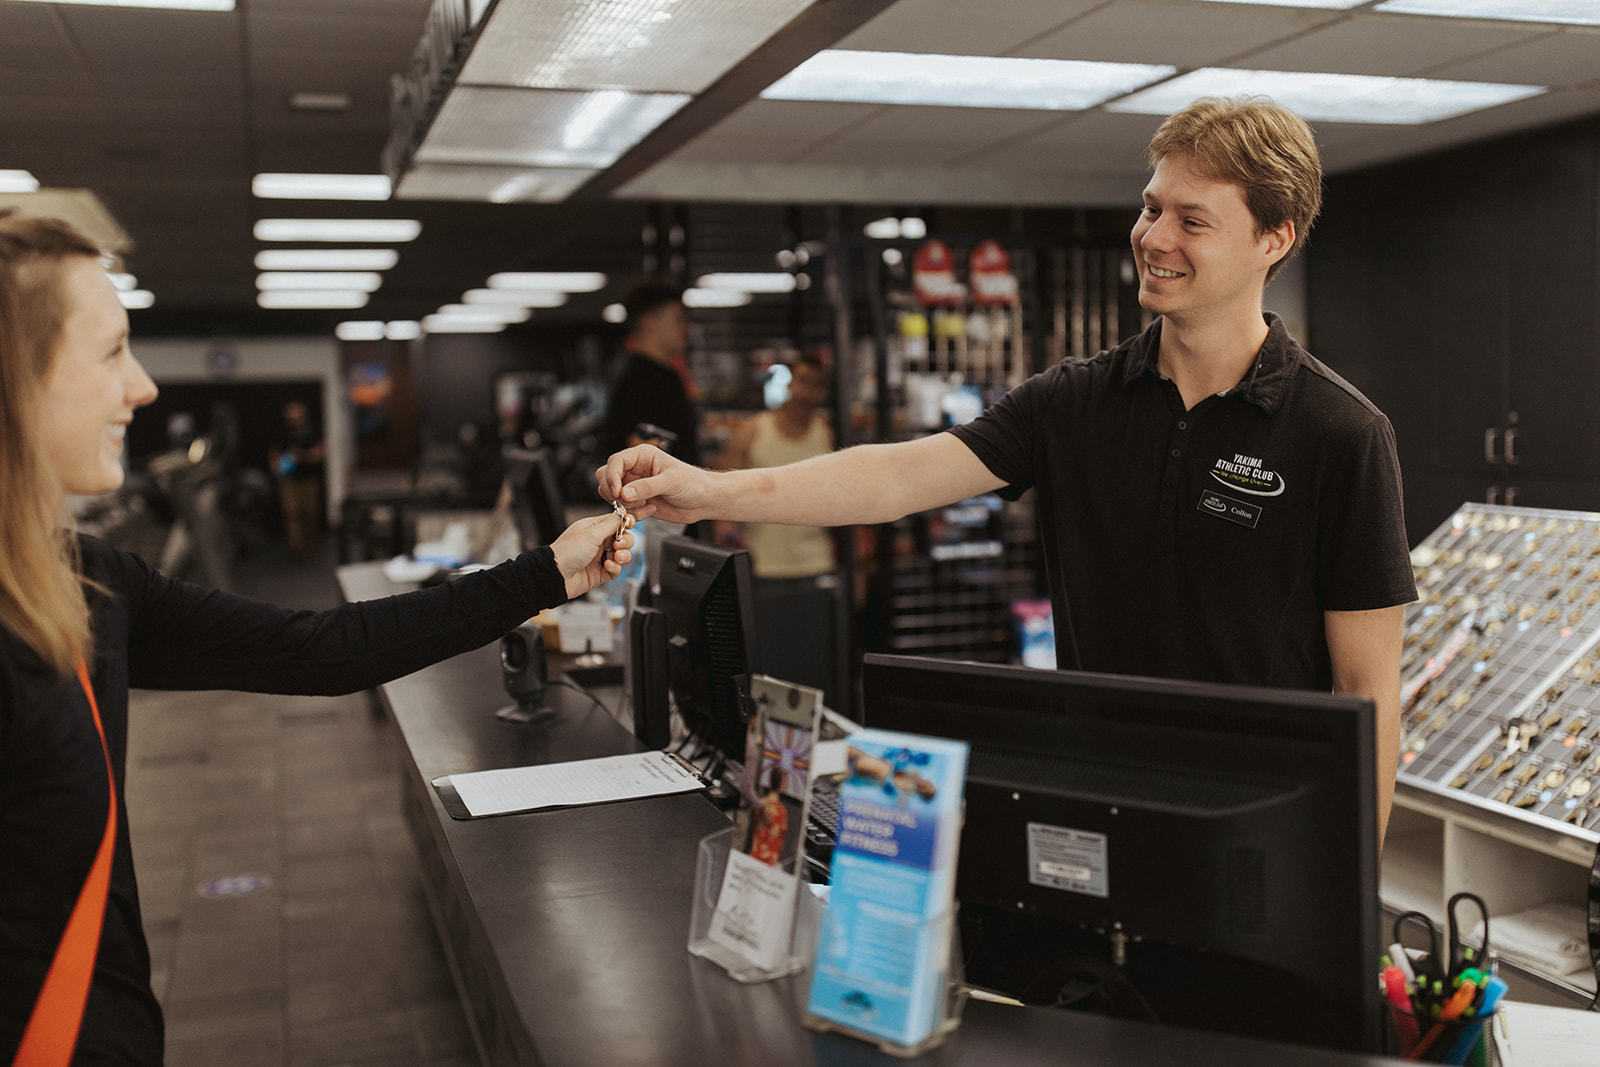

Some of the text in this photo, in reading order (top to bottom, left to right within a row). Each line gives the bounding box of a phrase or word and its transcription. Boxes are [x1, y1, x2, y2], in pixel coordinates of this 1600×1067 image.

[1233, 453, 1262, 468] YAKIMA
[1215, 459, 1274, 481] ATHLETIC CLUB
